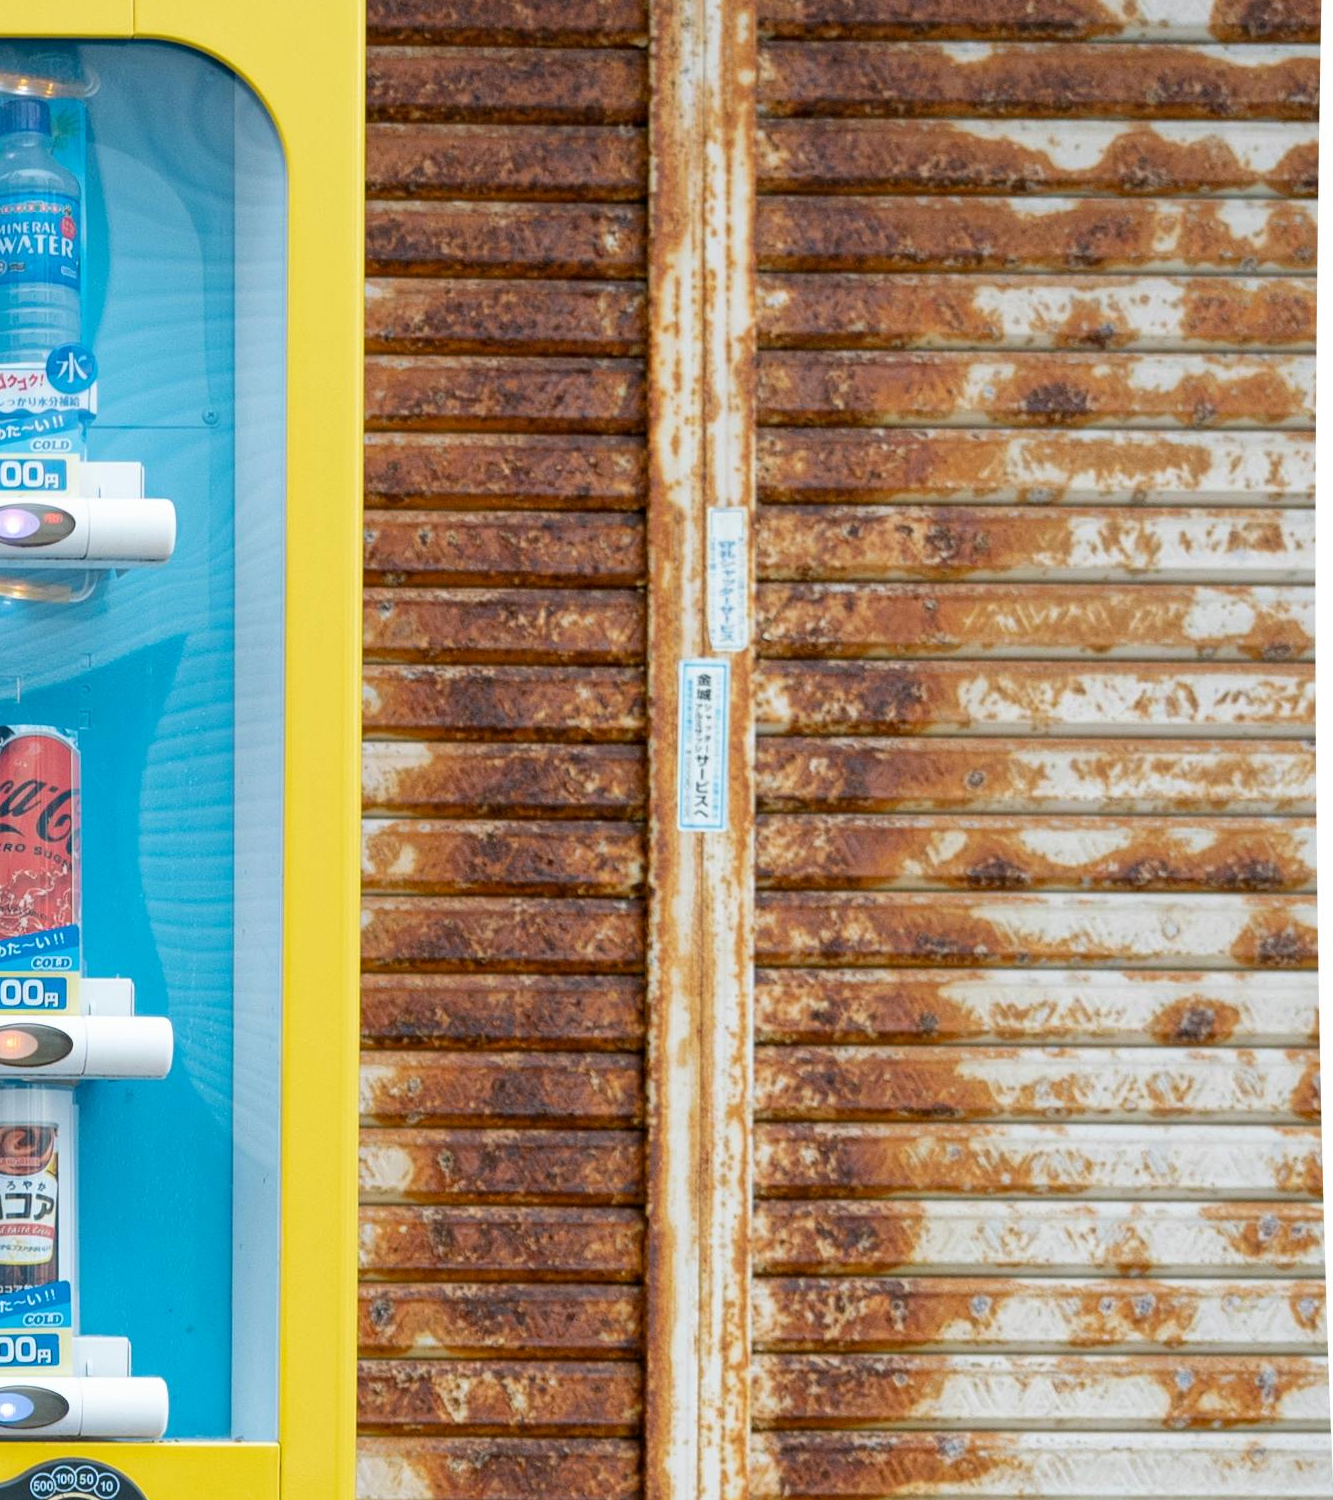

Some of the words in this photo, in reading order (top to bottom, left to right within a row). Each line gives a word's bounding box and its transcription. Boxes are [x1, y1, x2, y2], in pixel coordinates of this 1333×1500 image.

[56, 359, 89, 383] 水
[31, 438, 71, 451] COLD
[31, 957, 71, 970] COLD
[24, 1314, 64, 1327] COLD
[33, 1479, 53, 1493] 500
[56, 1472, 75, 1487] 100
[79, 1472, 94, 1486] 50
[100, 1479, 114, 1492] 10
